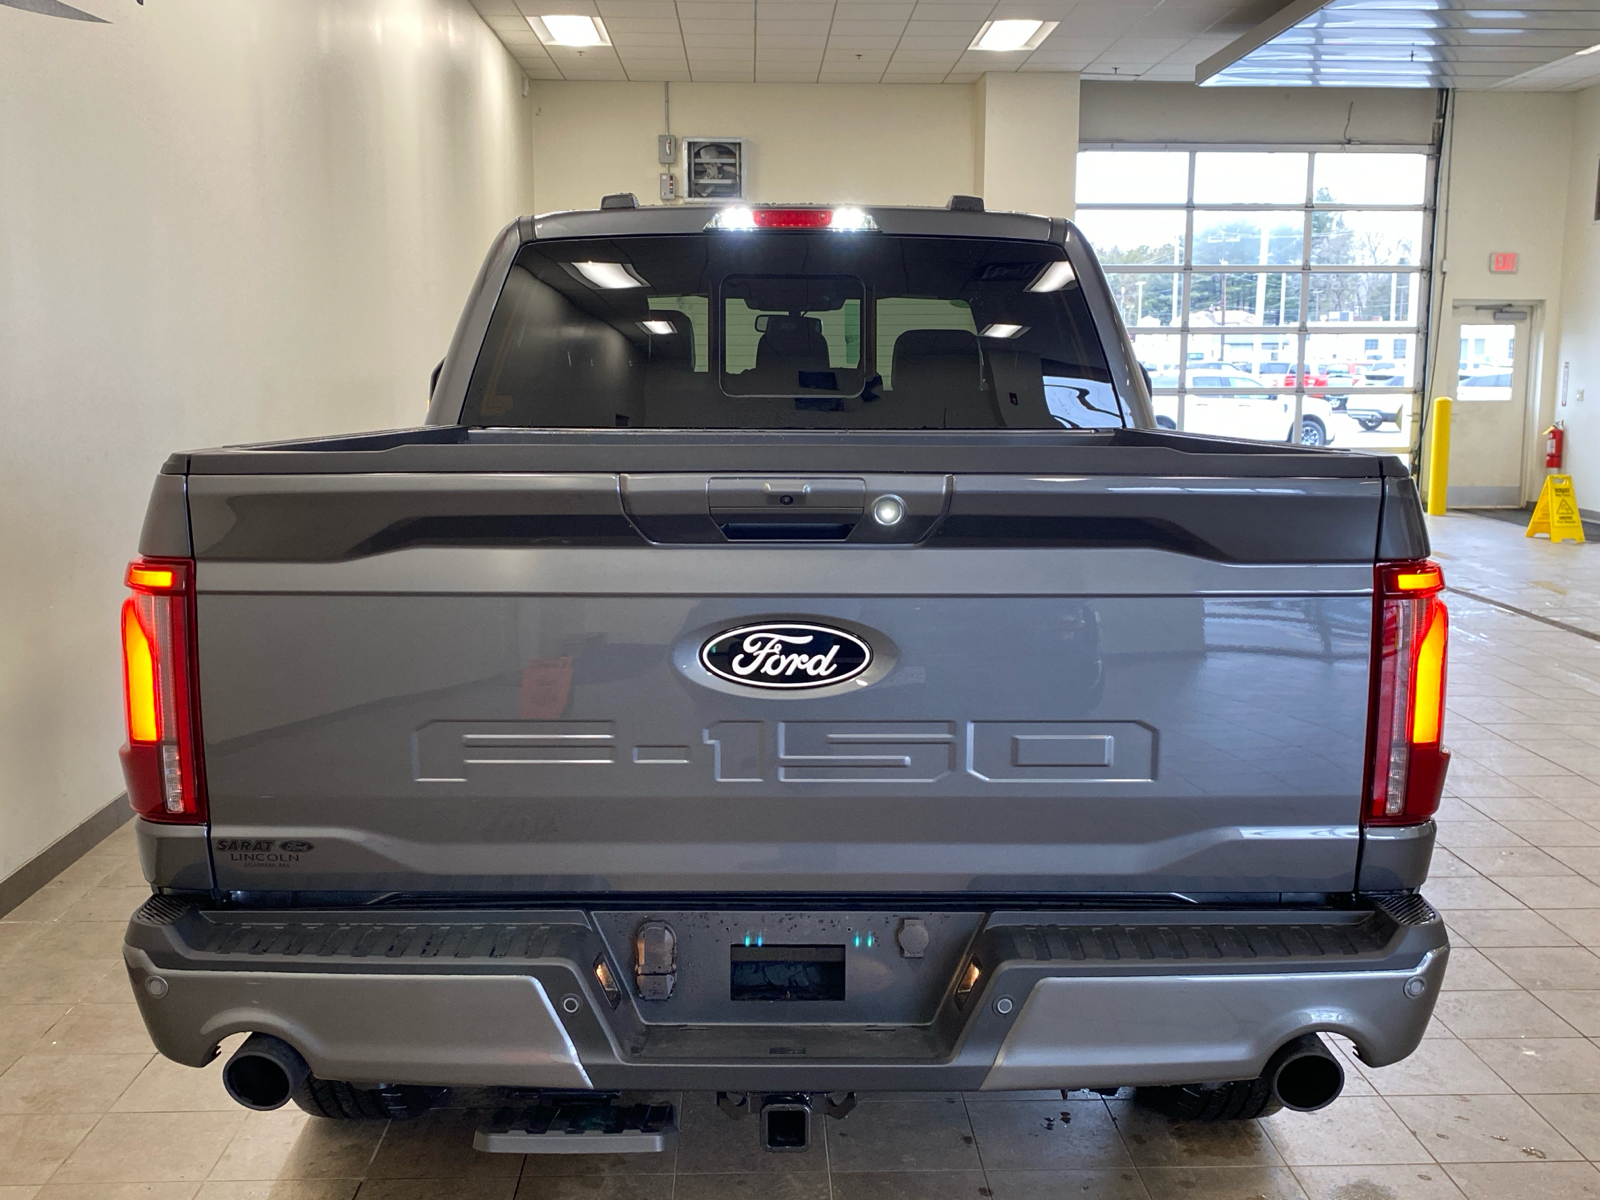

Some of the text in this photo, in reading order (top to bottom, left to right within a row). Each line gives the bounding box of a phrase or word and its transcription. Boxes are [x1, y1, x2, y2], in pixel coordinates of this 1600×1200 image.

[731, 632, 840, 676] Ford
[412, 719, 1159, 783] F-150
[216, 840, 275, 852] SARAT
[230, 853, 299, 862] LINCOLN
